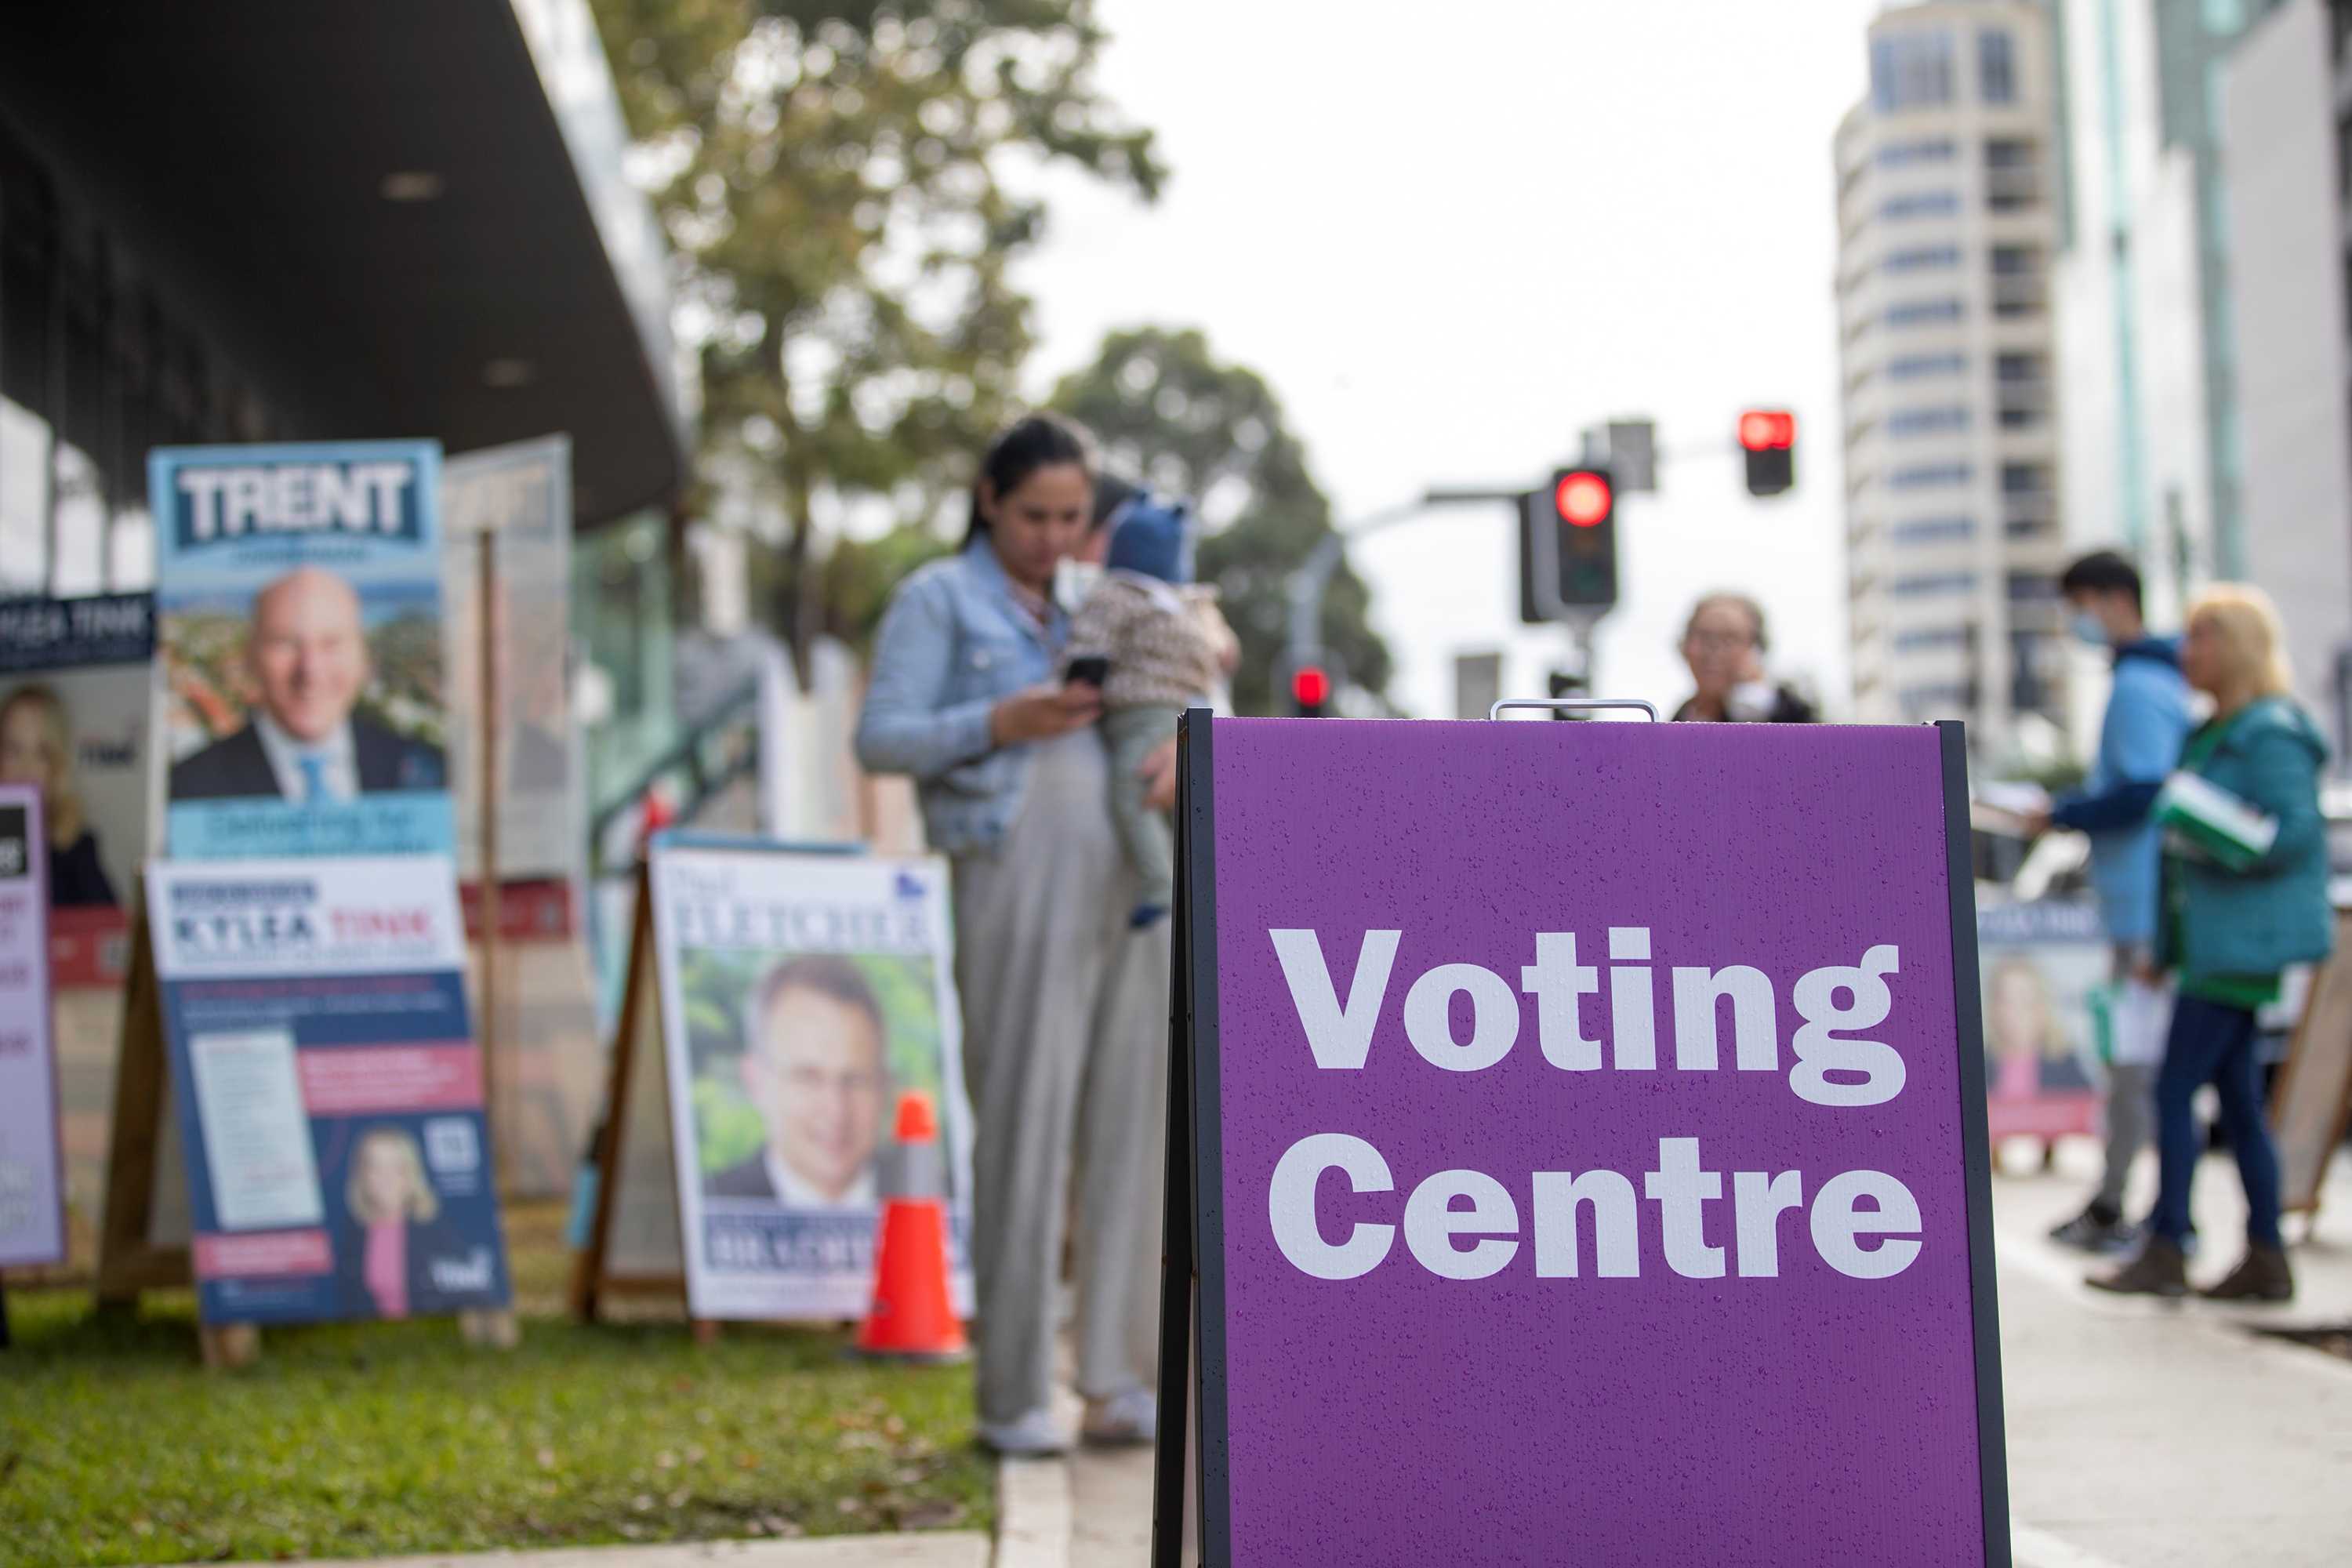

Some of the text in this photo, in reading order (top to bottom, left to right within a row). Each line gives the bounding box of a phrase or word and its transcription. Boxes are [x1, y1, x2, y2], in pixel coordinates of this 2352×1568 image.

[175, 461, 414, 542] TRENT
[171, 904, 434, 947] KYLEA TINK
[1268, 927, 1907, 1106] Voting
[1269, 1133, 1923, 1279] Centre
